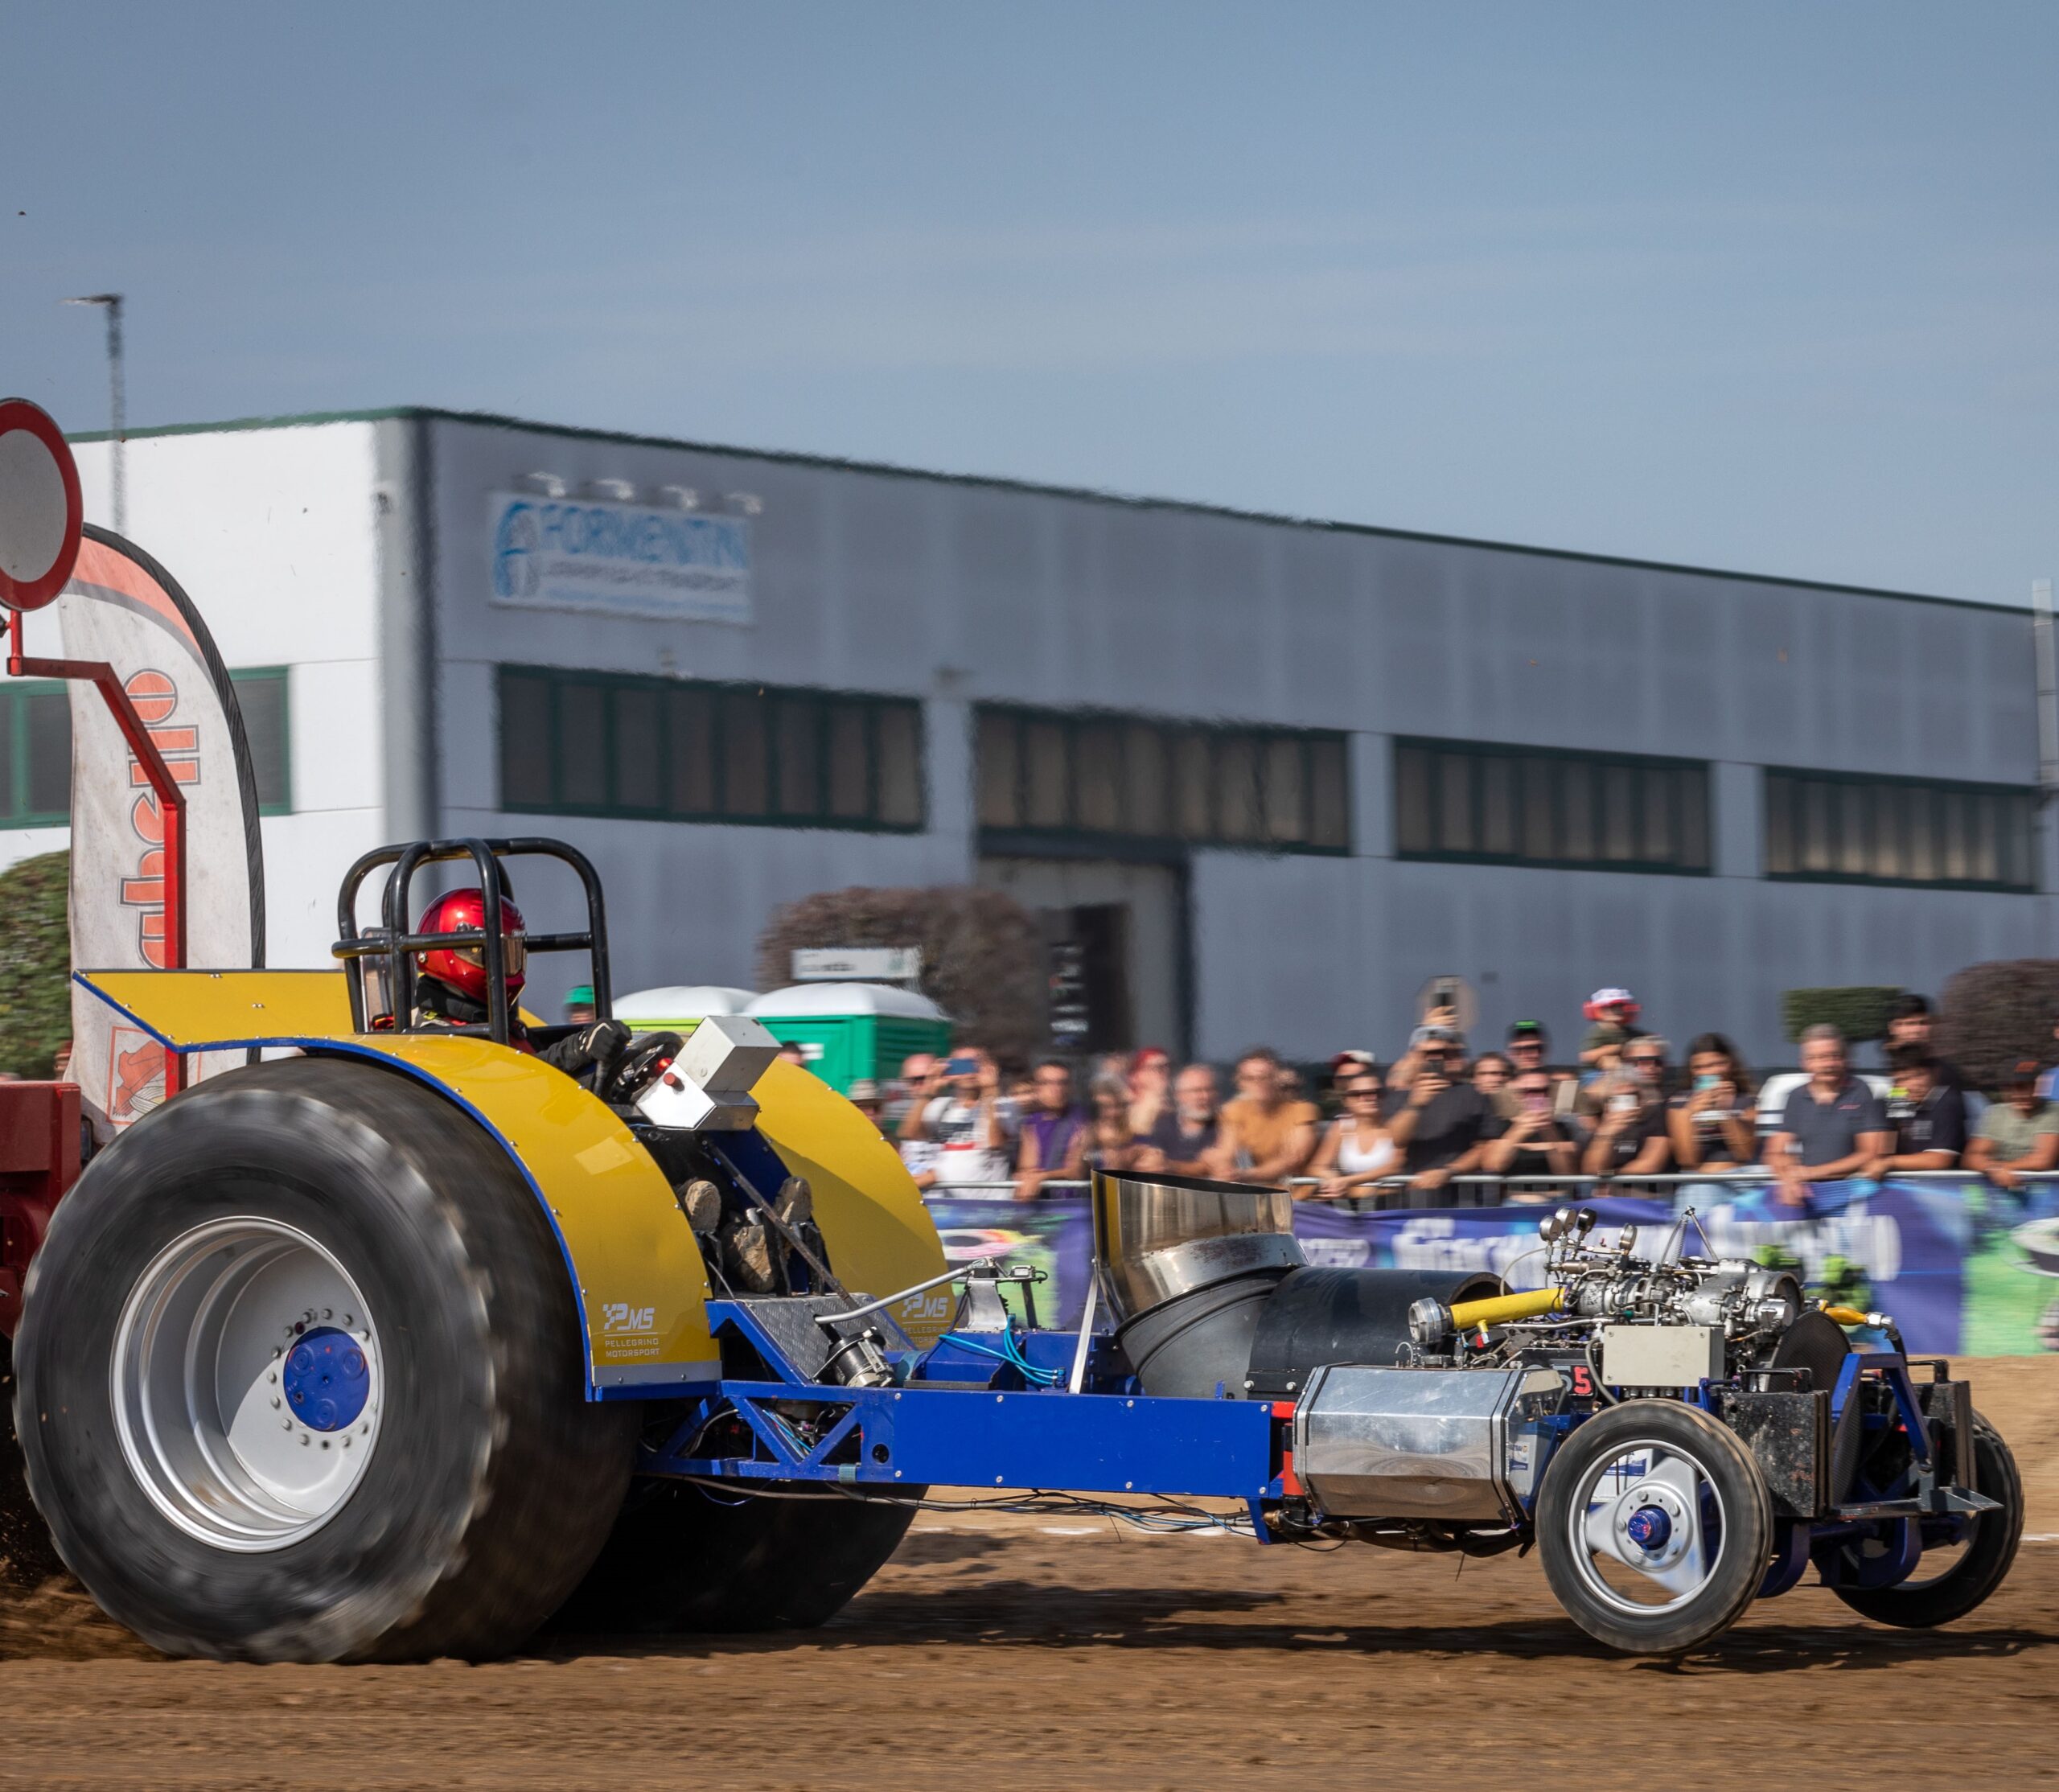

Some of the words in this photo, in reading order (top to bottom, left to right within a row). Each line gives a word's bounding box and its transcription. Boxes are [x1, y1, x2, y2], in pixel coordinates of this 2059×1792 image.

[602, 1303, 656, 1330] PMS
[901, 1292, 948, 1318] PMS
[605, 1338, 659, 1347] PELLEGRINO
[606, 1348, 660, 1358] MOTORSPORT
[1573, 1366, 1592, 1395] 5
